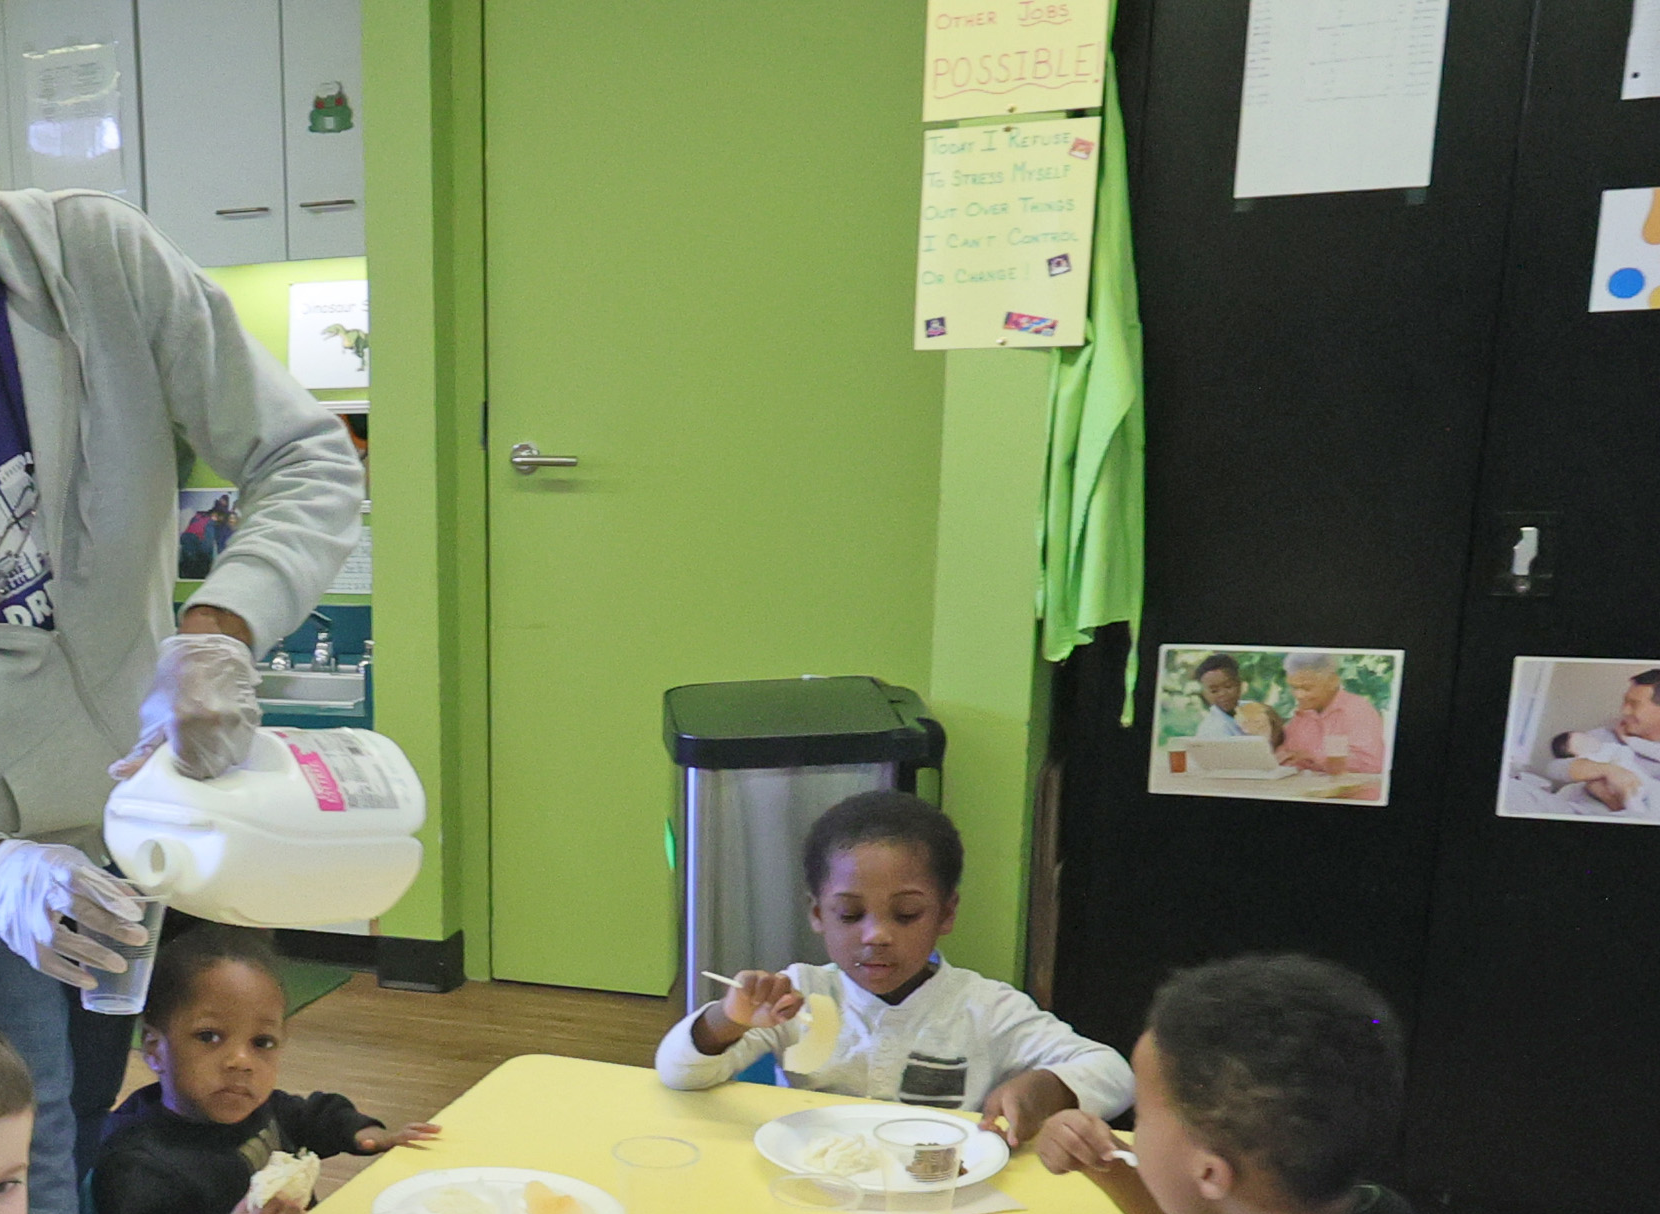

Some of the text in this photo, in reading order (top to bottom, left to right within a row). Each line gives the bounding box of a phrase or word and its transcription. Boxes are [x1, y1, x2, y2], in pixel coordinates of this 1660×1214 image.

[936, 1, 1069, 30] OTHER JOBS
[934, 41, 1102, 91] POSSIBLE!
[926, 135, 975, 154] TODAY
[1007, 128, 1072, 148] REFUSE
[950, 169, 1005, 187] STRESS
[1011, 161, 1072, 183] MYSELF
[923, 196, 1076, 221] OUT OVER THINGS
[1007, 227, 1080, 246] CONTROL
